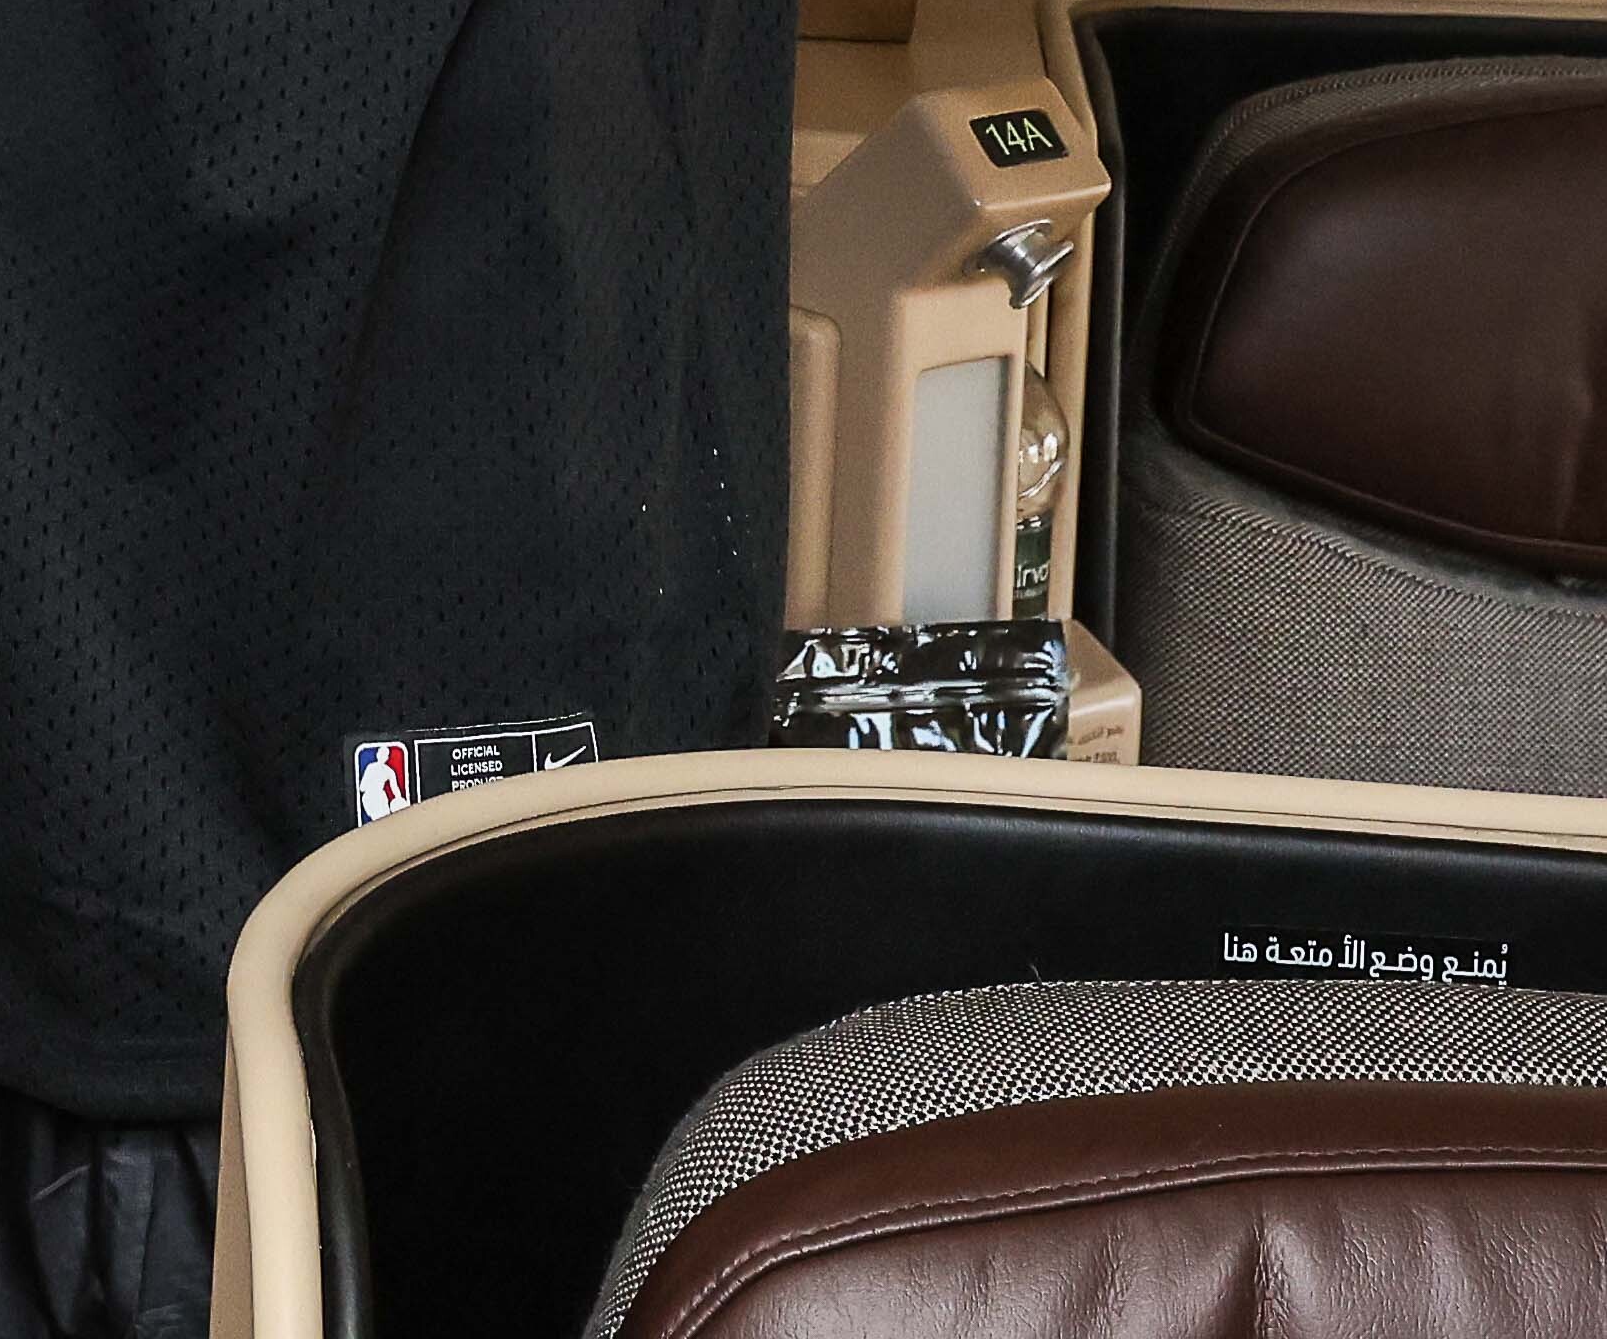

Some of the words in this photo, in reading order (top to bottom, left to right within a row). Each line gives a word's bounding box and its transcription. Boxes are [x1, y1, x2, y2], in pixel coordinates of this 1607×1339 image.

[985, 117, 1054, 156] 14A
[450, 760, 503, 776] LICENSED
[452, 745, 501, 760] OFFICIAL
[1224, 932, 1258, 963] هنا
[1369, 946, 1435, 981] وضع
